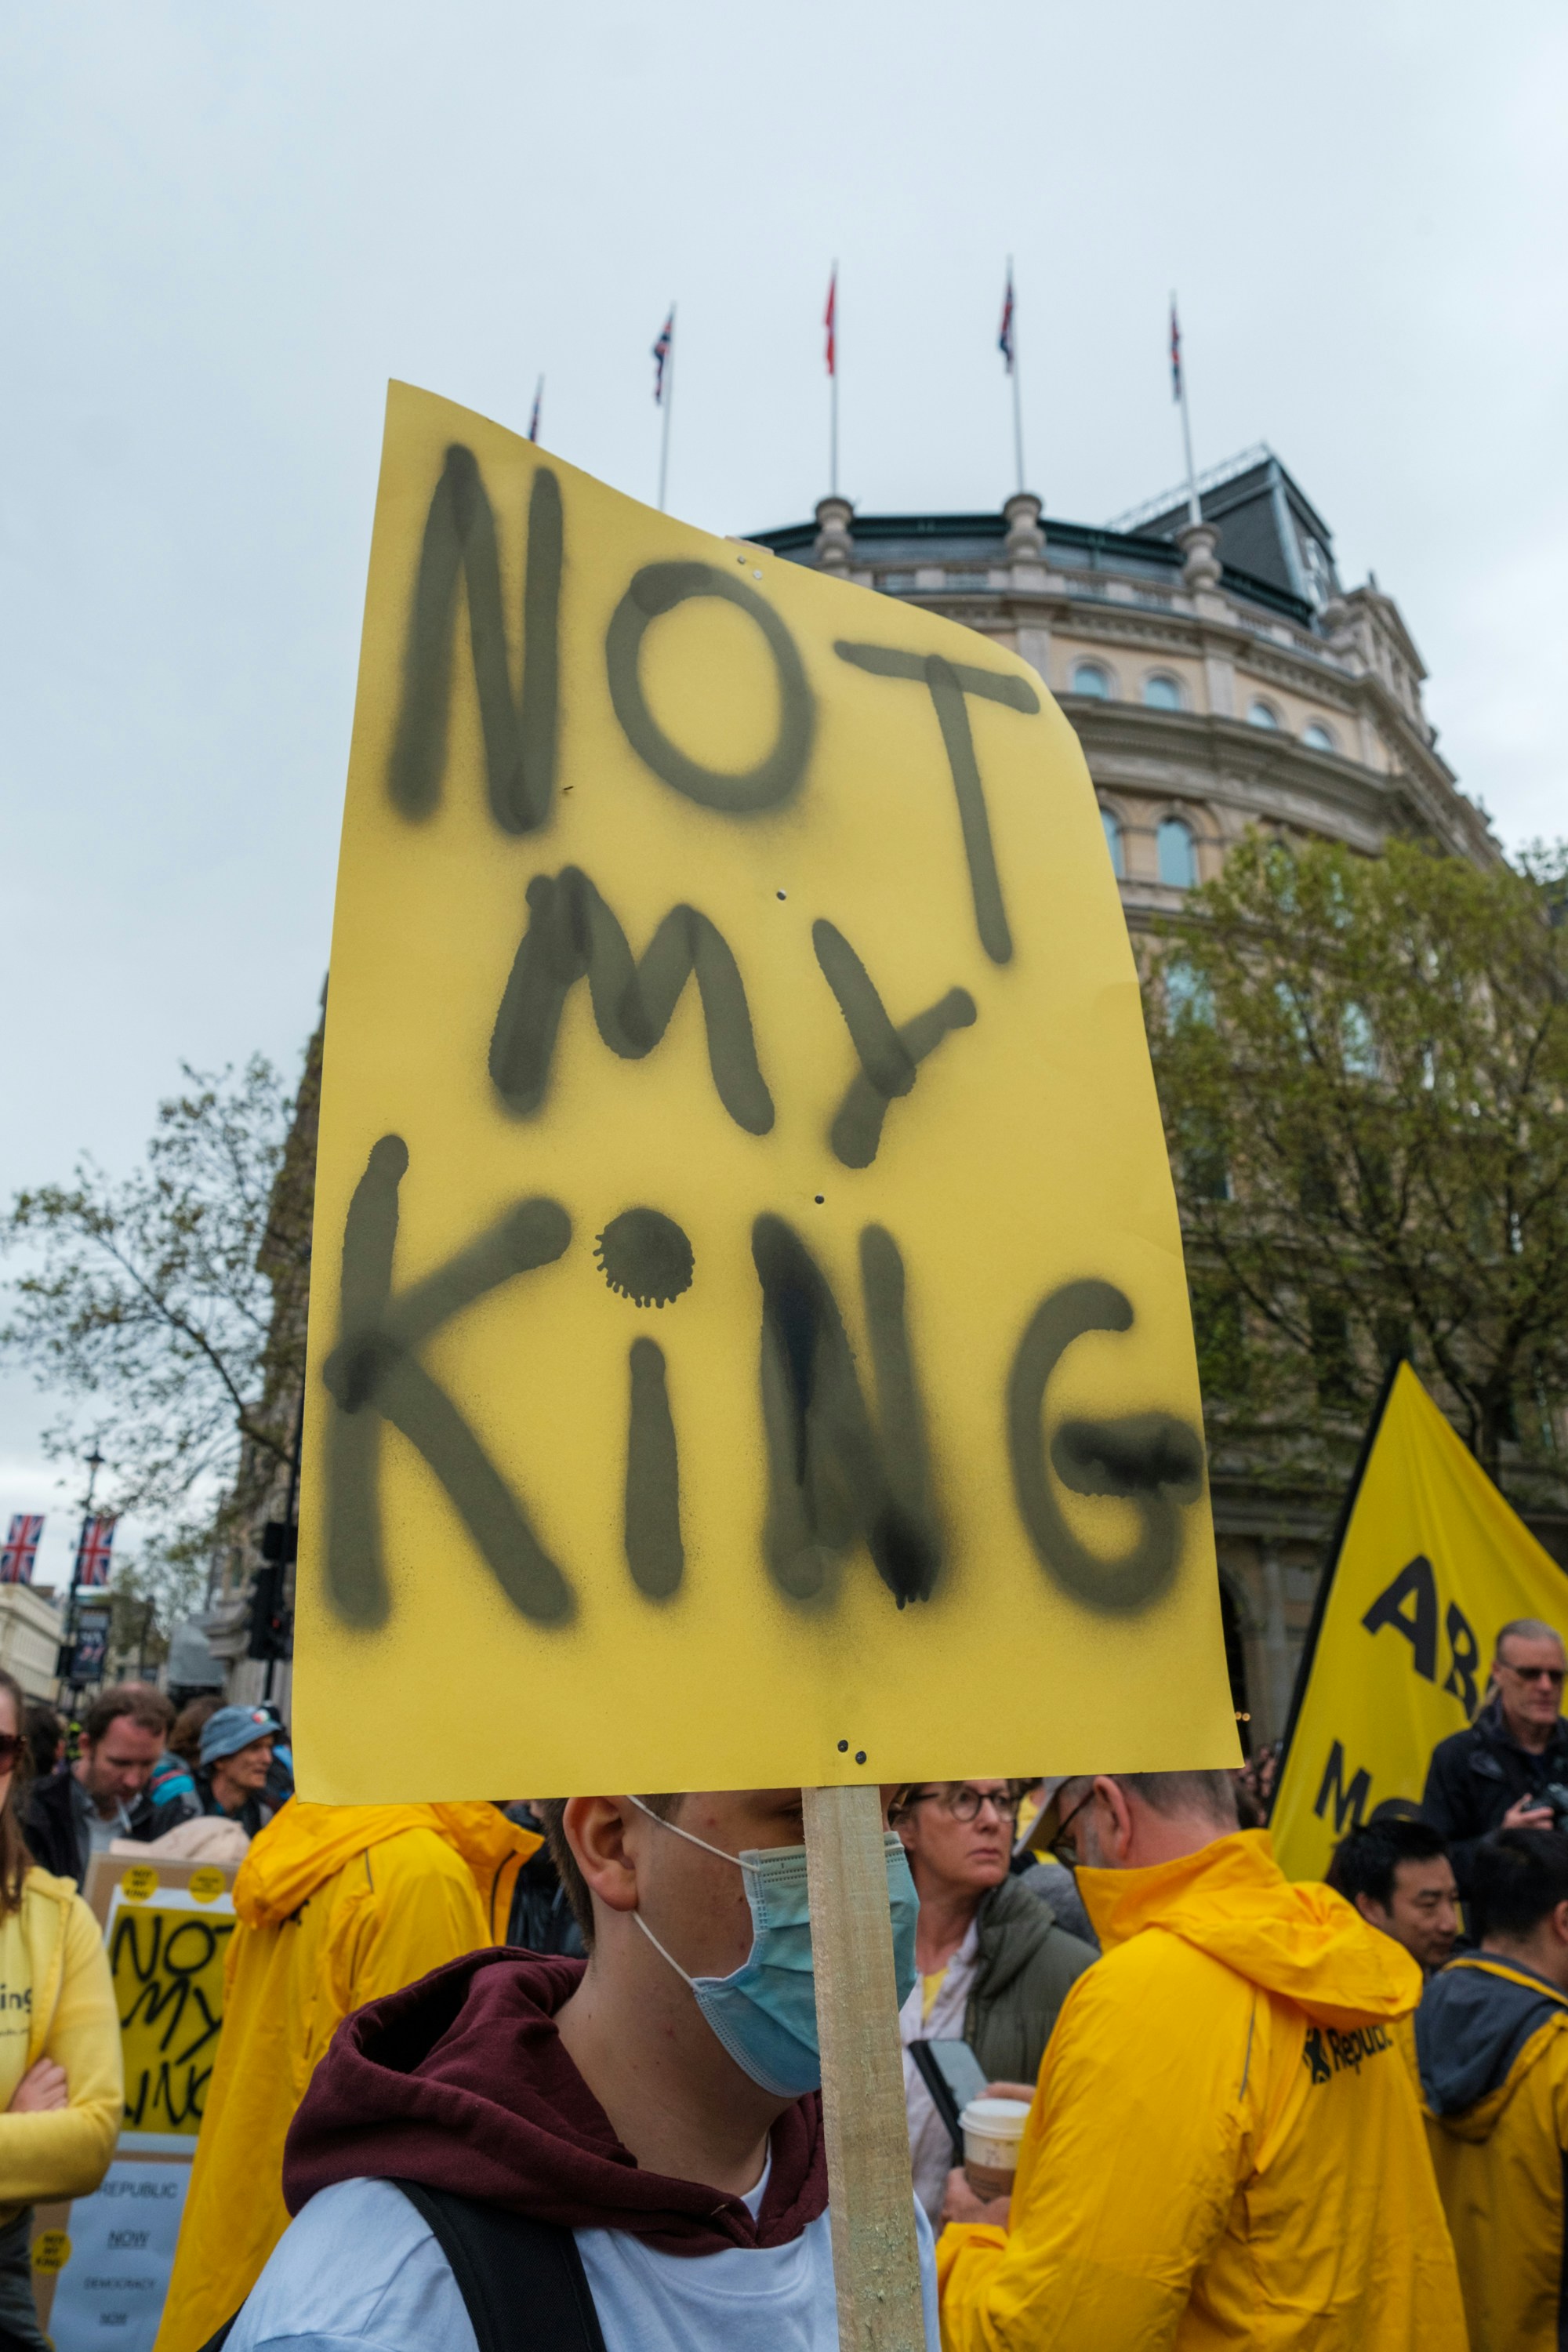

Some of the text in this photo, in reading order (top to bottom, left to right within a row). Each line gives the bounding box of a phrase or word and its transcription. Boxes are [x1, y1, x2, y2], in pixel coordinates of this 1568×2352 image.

[387, 441, 1040, 964] NOT
[488, 865, 978, 1170] MY
[121, 1976, 223, 2066] MY
[100, 2180, 178, 2199] REPUBLIC
[107, 2230, 150, 2249] NOW
